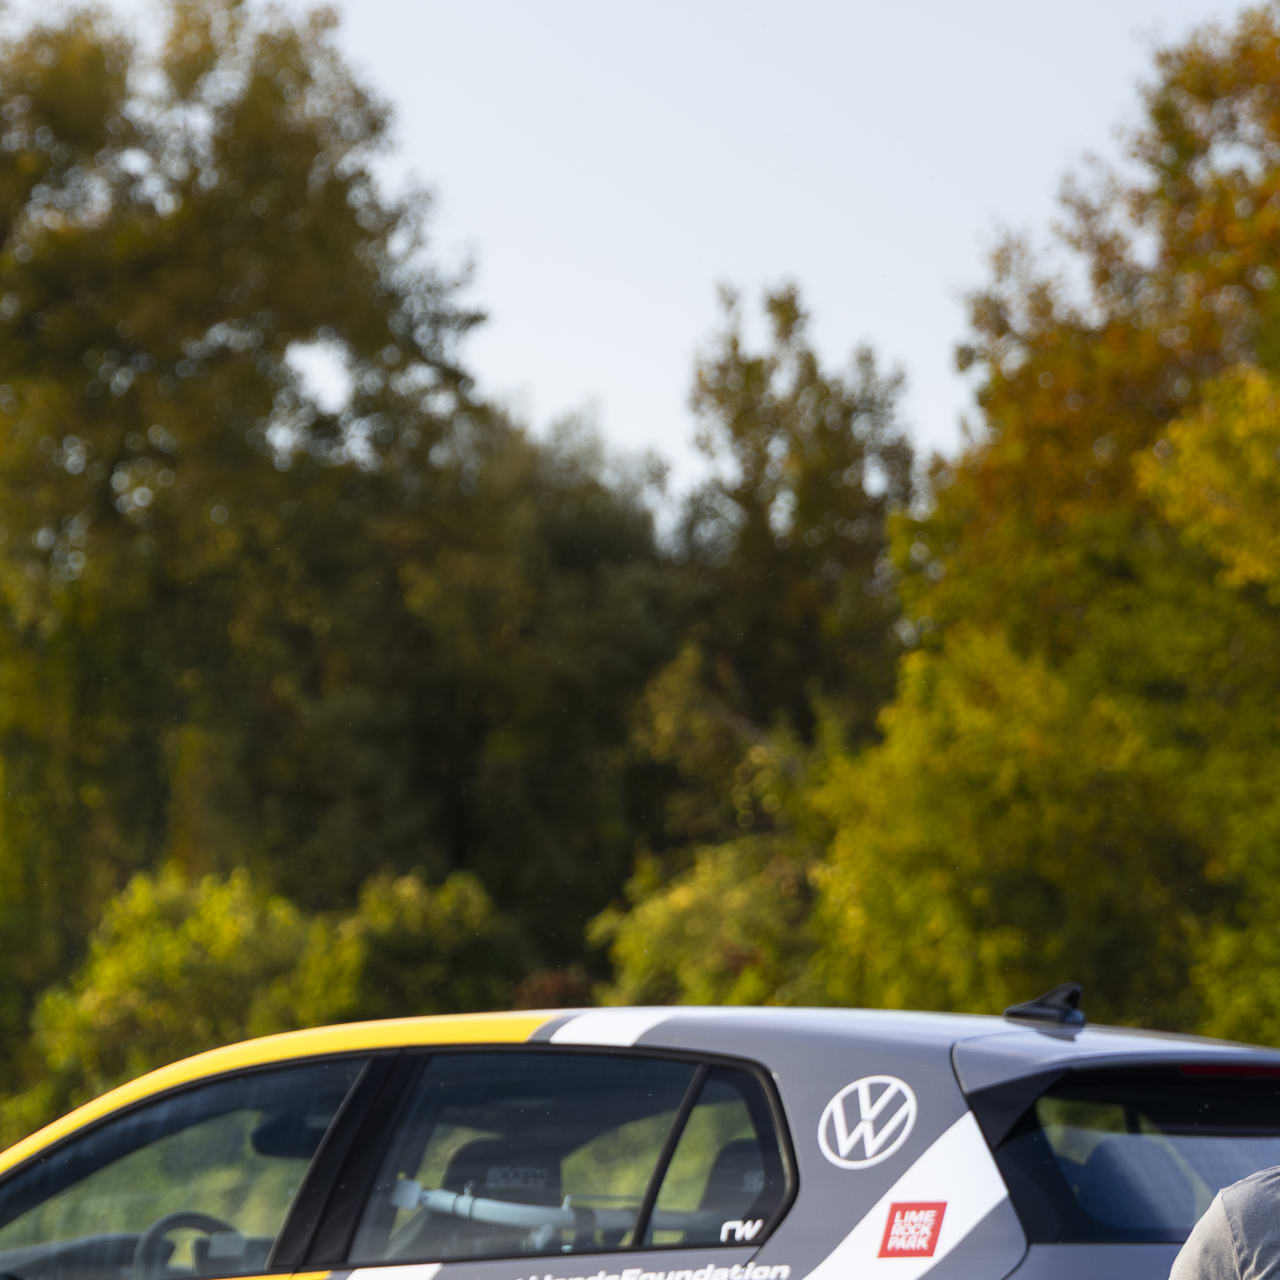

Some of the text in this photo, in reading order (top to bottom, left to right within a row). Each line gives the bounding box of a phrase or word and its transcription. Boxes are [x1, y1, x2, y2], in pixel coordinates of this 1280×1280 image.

[822, 1077, 915, 1165] VW
[894, 1209, 937, 1223] LIME
[891, 1223, 933, 1237] ROCK
[887, 1236, 930, 1251] PARK
